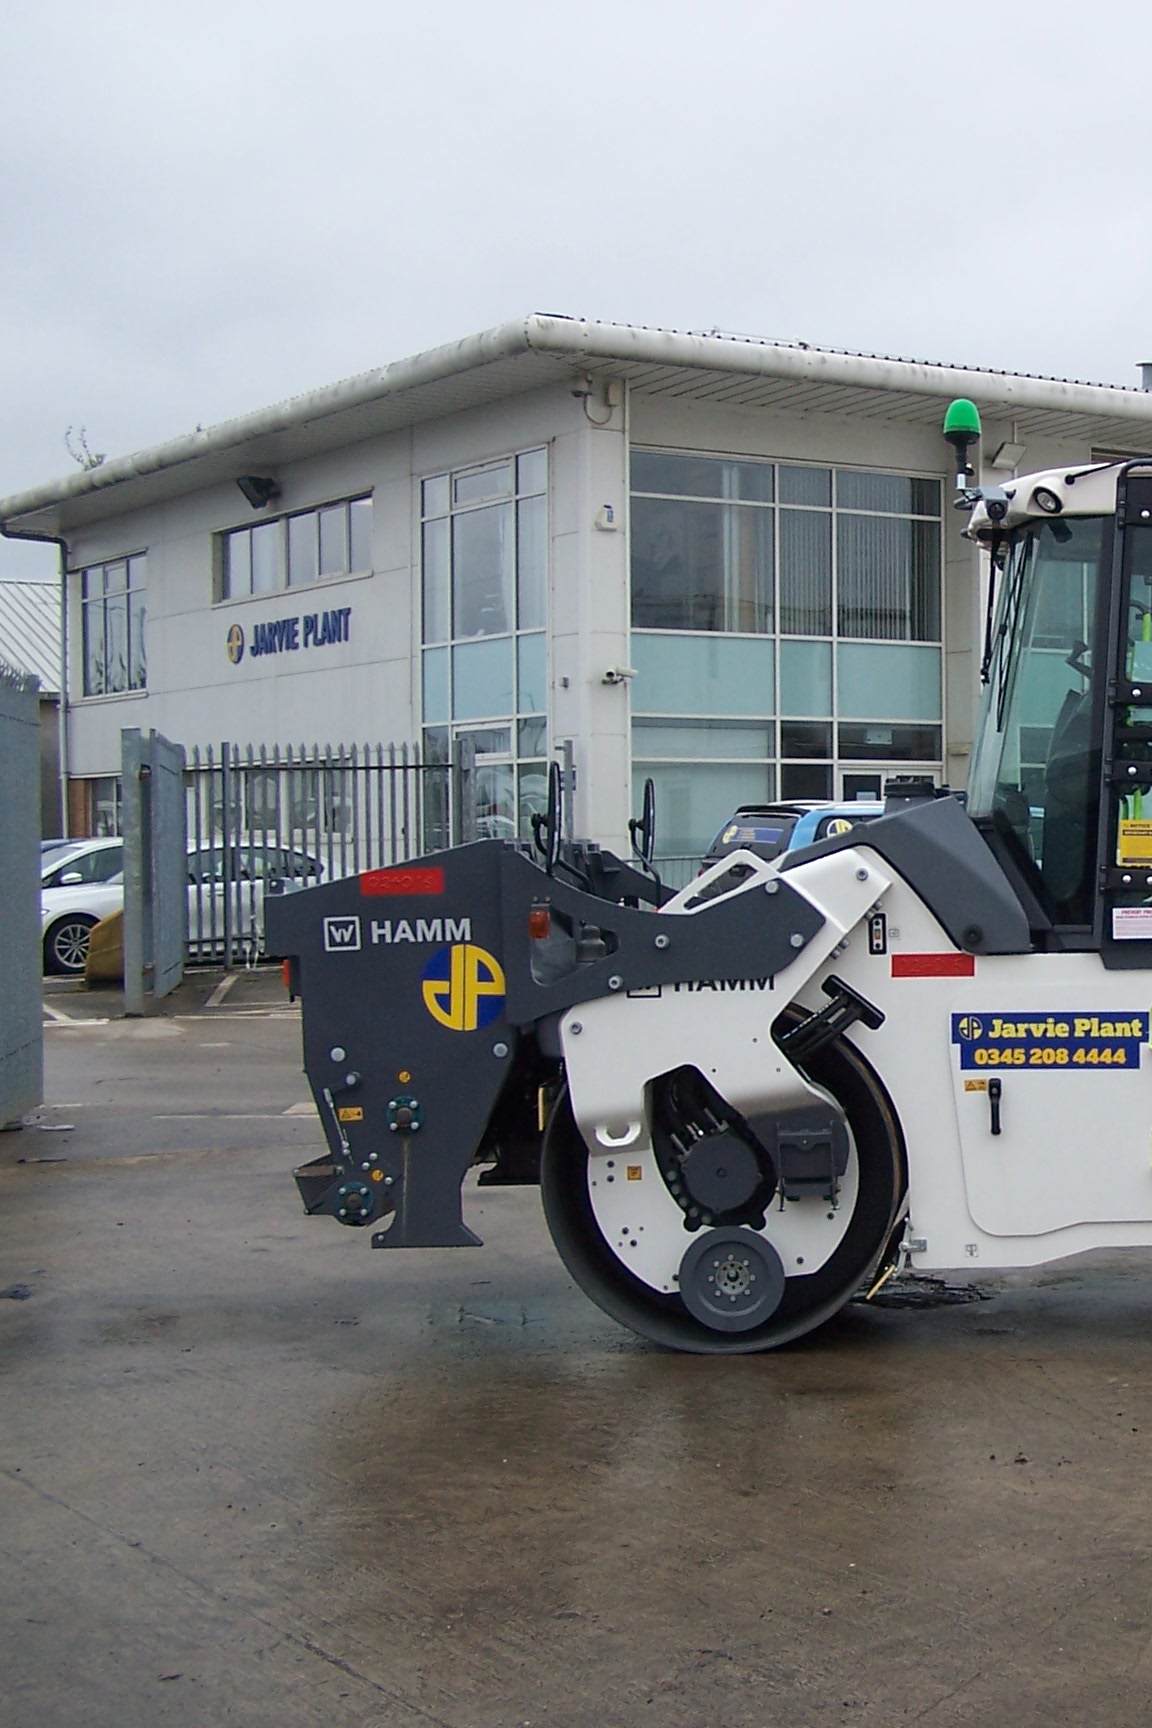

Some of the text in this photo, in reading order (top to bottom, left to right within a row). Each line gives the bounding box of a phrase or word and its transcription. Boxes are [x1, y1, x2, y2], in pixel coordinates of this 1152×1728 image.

[250, 607, 351, 657] JARVIE PLANT
[371, 918, 472, 944] HAMM
[988, 1018, 1070, 1038] Jarvie
[1074, 1018, 1142, 1038] Plant
[974, 1048, 1127, 1065] 0345 208 4444
